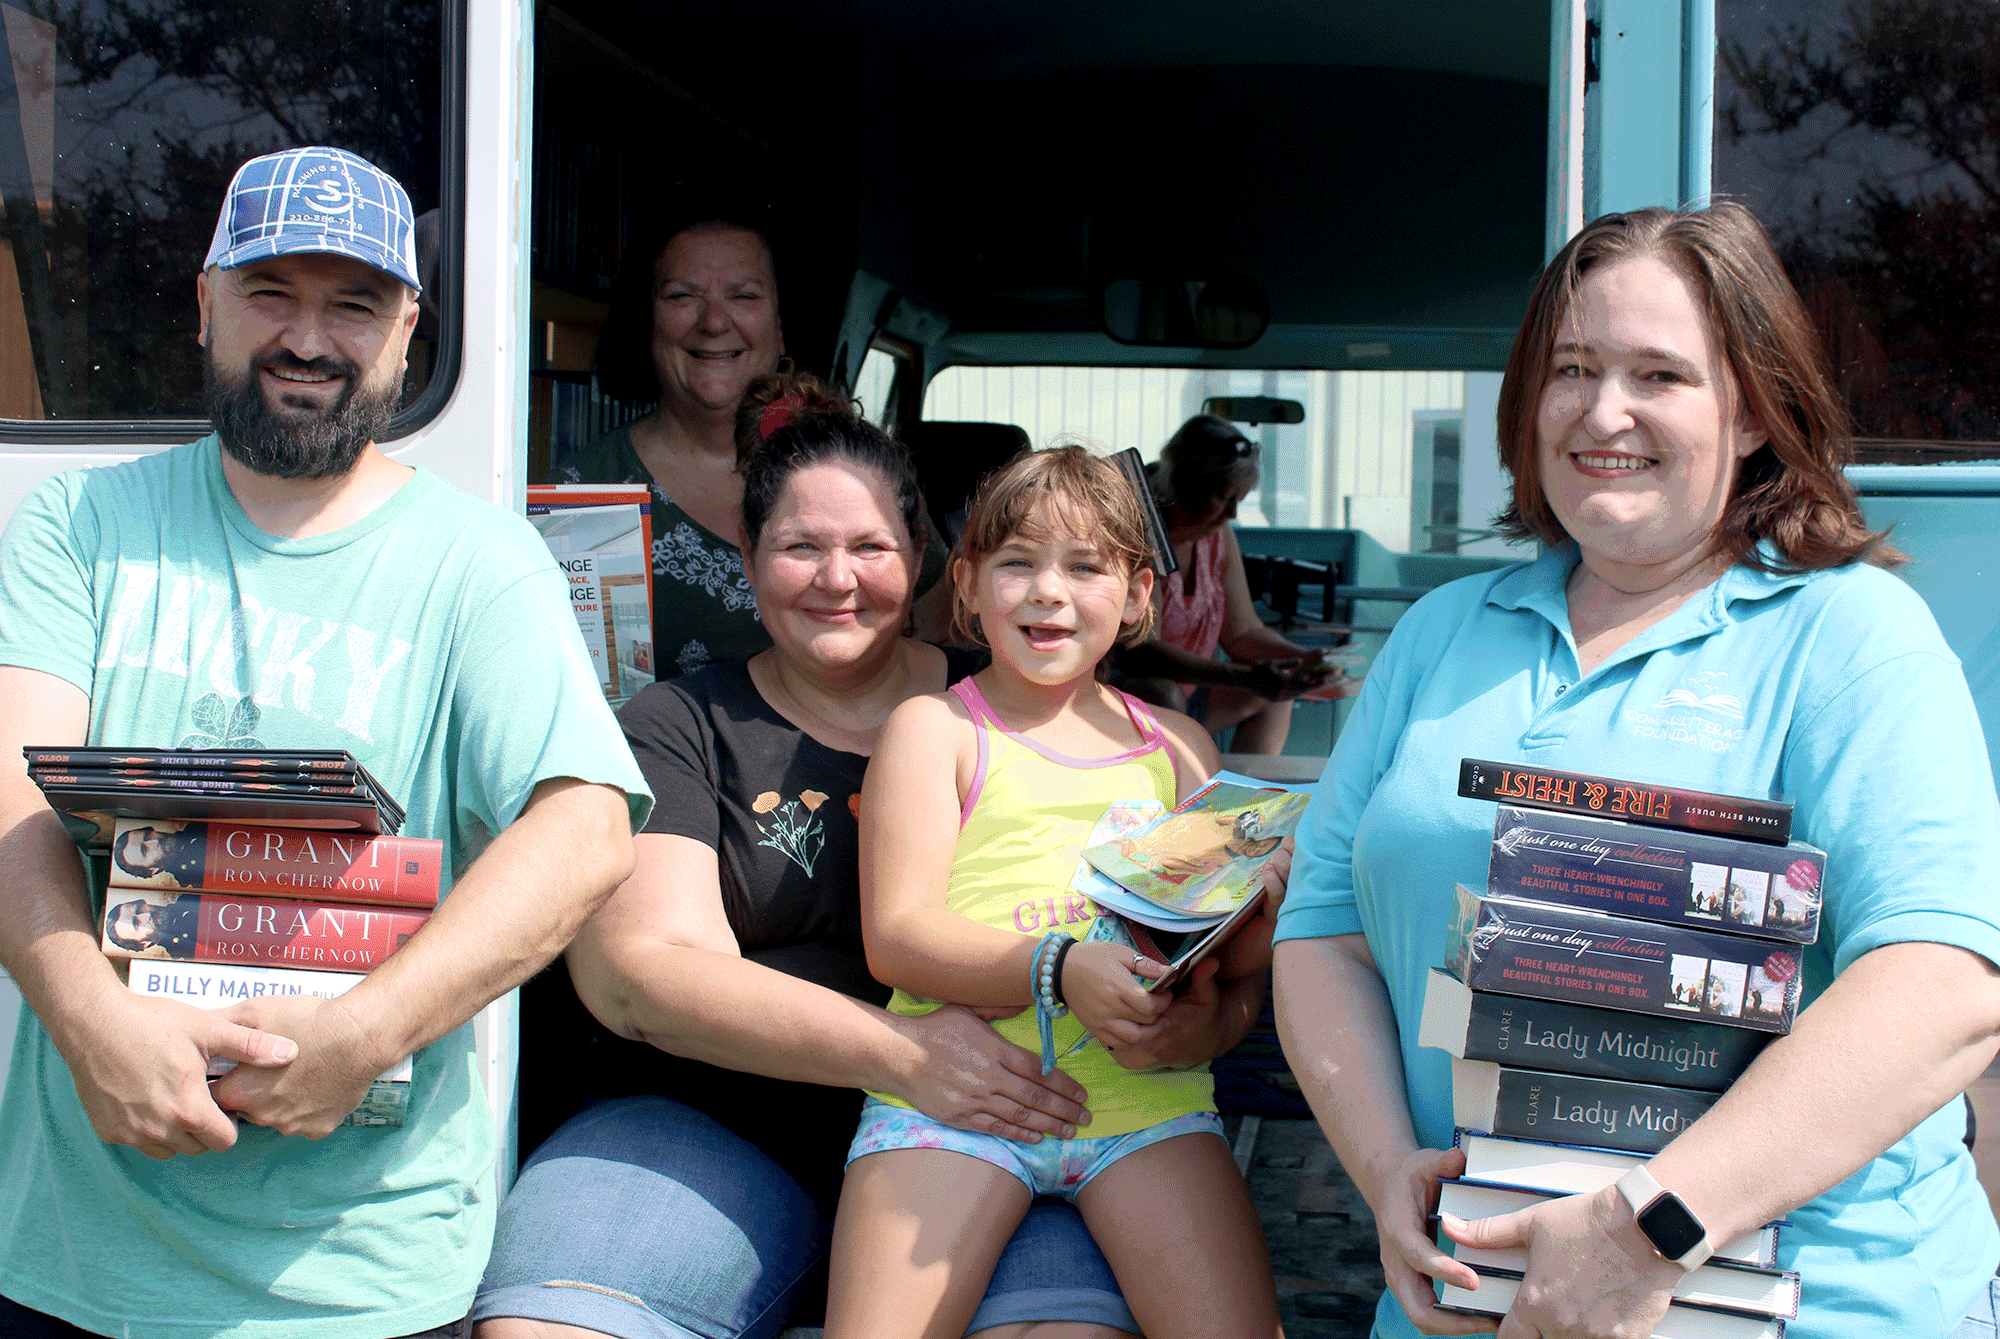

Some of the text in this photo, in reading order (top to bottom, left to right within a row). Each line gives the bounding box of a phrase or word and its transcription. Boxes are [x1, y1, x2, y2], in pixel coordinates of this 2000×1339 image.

[559, 559, 593, 573] NGE
[568, 576, 590, 585] ACE,
[573, 604, 599, 613] TURE
[96, 564, 412, 746] LUCKY
[1679, 715, 1746, 740] LITERAC
[36, 766, 68, 774] OLSON
[37, 754, 347, 769] OLSON NINJA BUNNY KNOPF
[44, 775, 356, 794] OLSON NINJA BUNNY KNOPF
[1471, 765, 1480, 793] CROWN
[1494, 770, 1672, 819] FIRE & HEIST
[1685, 806, 1779, 826] SARAH BETH DURST
[225, 830, 387, 868] GRANT
[1502, 831, 1685, 866] just one day collection
[224, 868, 385, 892] RON CHERNOW
[1520, 877, 1671, 907] BEAUTIFUL STORIES IN ONE BOX.
[1532, 864, 1664, 892] THREE HEART-WRENCHINGLY
[217, 903, 378, 940] GRANT
[216, 941, 376, 964] RON CHERNOW
[1483, 924, 1666, 958] just one day collection
[1502, 968, 1651, 999] BEAUTIFUL STORIES IN ONE BOX.
[1513, 956, 1644, 985] THREE HEART-WRENCHINGLY
[147, 973, 212, 996] BILLY
[219, 979, 302, 999] MARTIN
[1498, 1009, 1513, 1050] CLARE
[1524, 1020, 1720, 1072] Lady Midnight
[1526, 1085, 1541, 1126] CLARE
[1552, 1095, 1694, 1134] Lady Midn
